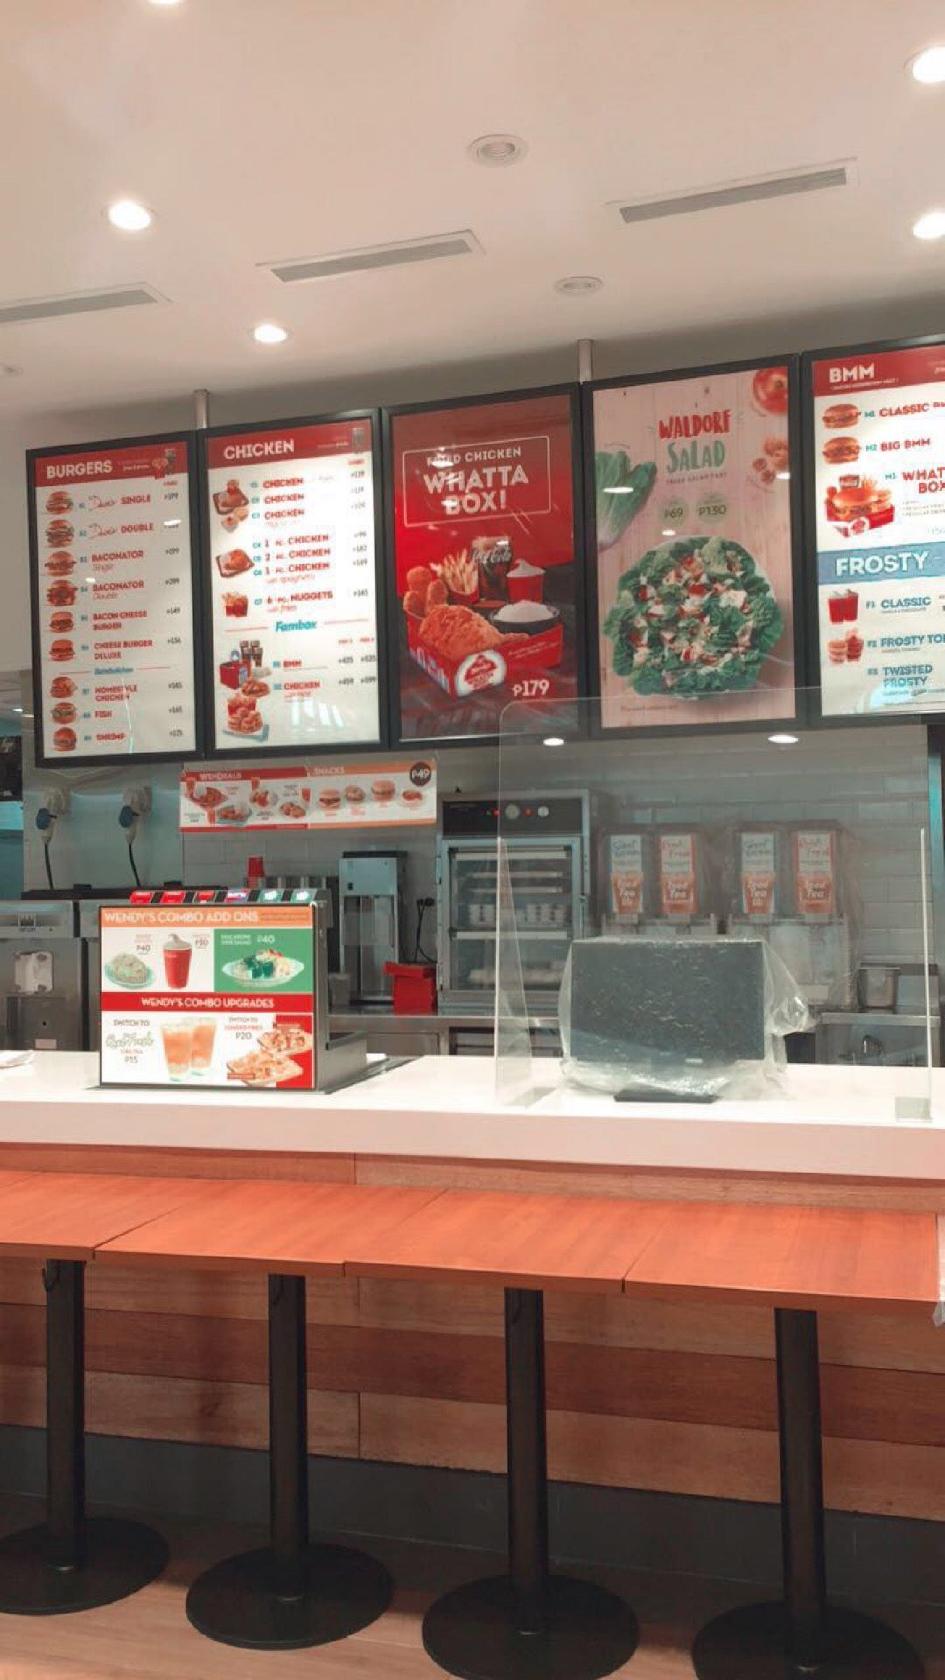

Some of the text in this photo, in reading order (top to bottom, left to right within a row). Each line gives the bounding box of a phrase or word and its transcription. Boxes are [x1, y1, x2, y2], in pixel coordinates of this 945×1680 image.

[829, 362, 875, 383] BMM
[879, 403, 929, 417] CLASSIC
[658, 409, 732, 439] WALDORF
[223, 439, 295, 460] CHICKEN
[880, 441, 900, 451] BIG
[904, 438, 931, 449] BMM
[465, 447, 521, 463] CHICKEN
[46, 460, 113, 479] BURGERS
[263, 478, 304, 489] CHICKEN
[423, 464, 529, 494] WHATTA
[120, 494, 151, 505] SINGLE
[264, 494, 304, 504] CHICKEN
[445, 489, 507, 515] BOX!
[264, 509, 304, 520] CHICKEN
[121, 523, 154, 534] DOUBLE
[288, 534, 329, 545] CHICKEN
[91, 550, 144, 562] BACONATOR
[288, 548, 331, 559] CHICKEN
[288, 562, 330, 572] CHICKEN
[836, 551, 929, 576] FROSTY
[92, 580, 145, 592] BACONATOR
[290, 590, 333, 602] NUGGETS
[881, 596, 932, 609] CLASSIC
[92, 612, 119, 621] BACON
[93, 622, 122, 631] BURGER
[275, 619, 318, 633] Fambox
[94, 641, 121, 650] CHEESE
[122, 640, 153, 649] BURGER
[881, 635, 925, 647] FROSTY
[94, 652, 122, 660] DELUXE
[882, 664, 933, 676] TWISTED
[284, 680, 320, 690] CHICKEN
[883, 676, 929, 688] FROSTY
[95, 710, 112, 718] FISH
[105, 911, 156, 923] WENDY'S
[158, 911, 204, 923] COMBO
[206, 911, 231, 923] ADD
[233, 910, 259, 922] ONS
[141, 998, 274, 1008] WENDY'S COMBO UPGRADES
